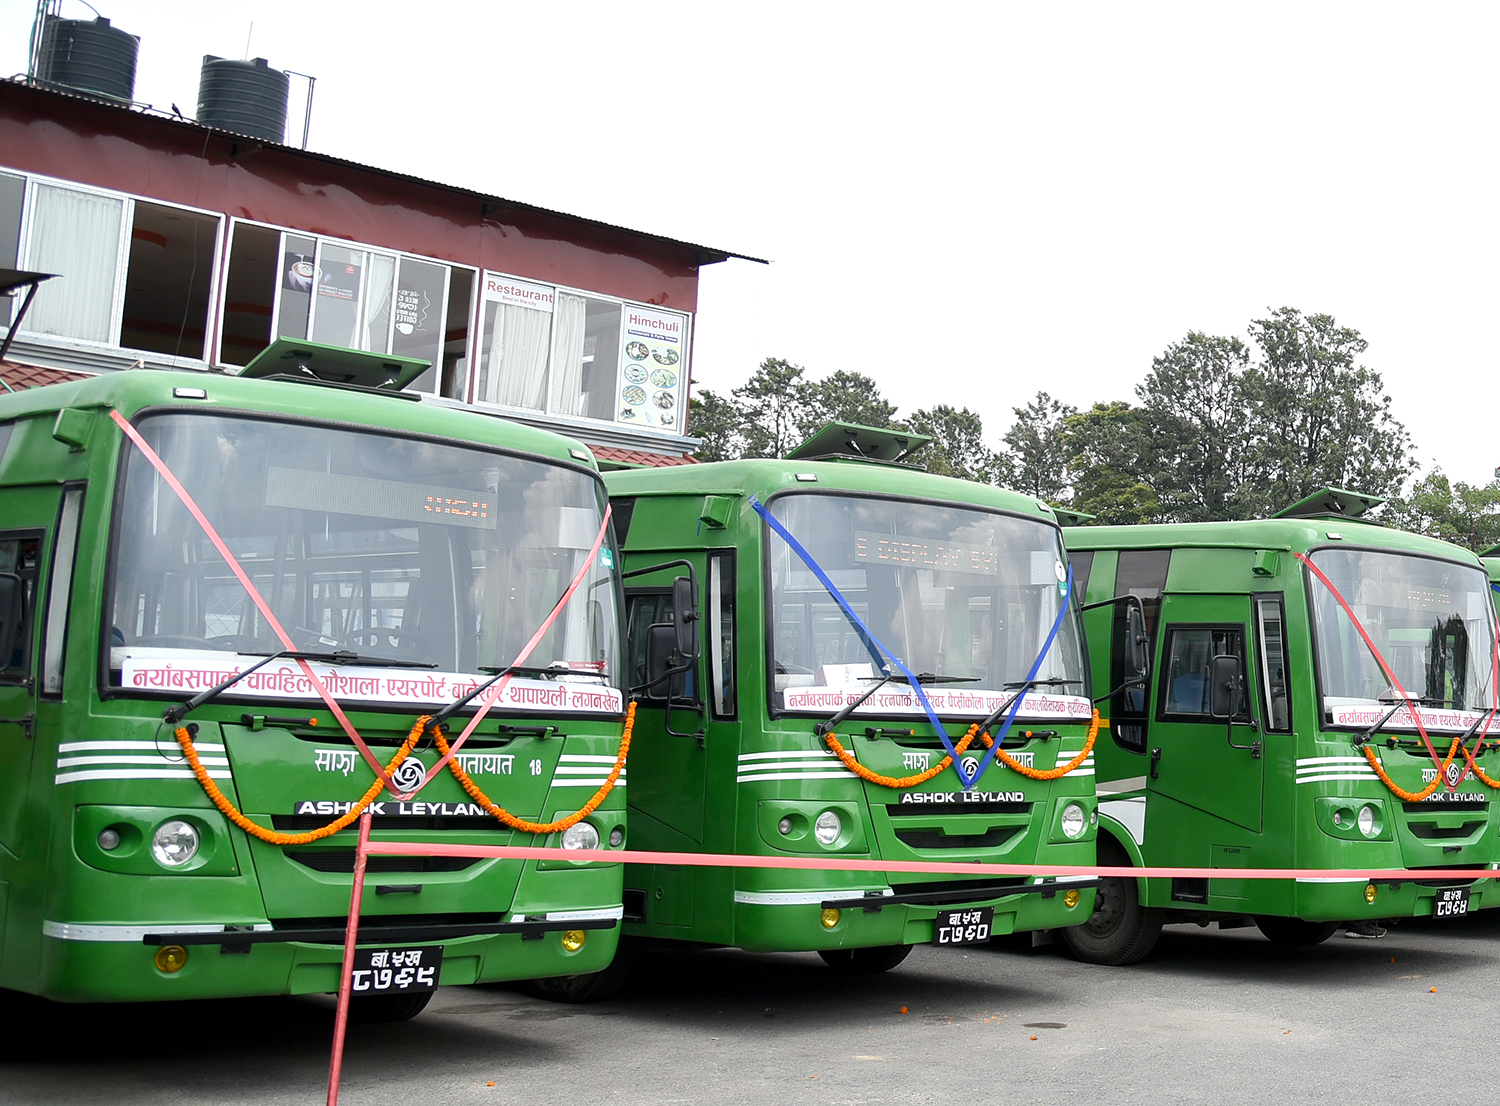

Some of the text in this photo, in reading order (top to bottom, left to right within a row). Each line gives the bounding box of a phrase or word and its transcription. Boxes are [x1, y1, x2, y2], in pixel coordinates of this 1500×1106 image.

[487, 280, 553, 304] Restaurant
[629, 314, 679, 332] Himchuli
[386, 675, 446, 698] एयरपोर्ट
[510, 685, 568, 707] थापाथली
[572, 689, 620, 712] लगनखेल
[454, 753, 515, 775] ातायात
[529, 759, 542, 776] 18
[901, 791, 1024, 803] ASHOK LEYLAND
[1423, 793, 1485, 802] HOK LEYLAND
